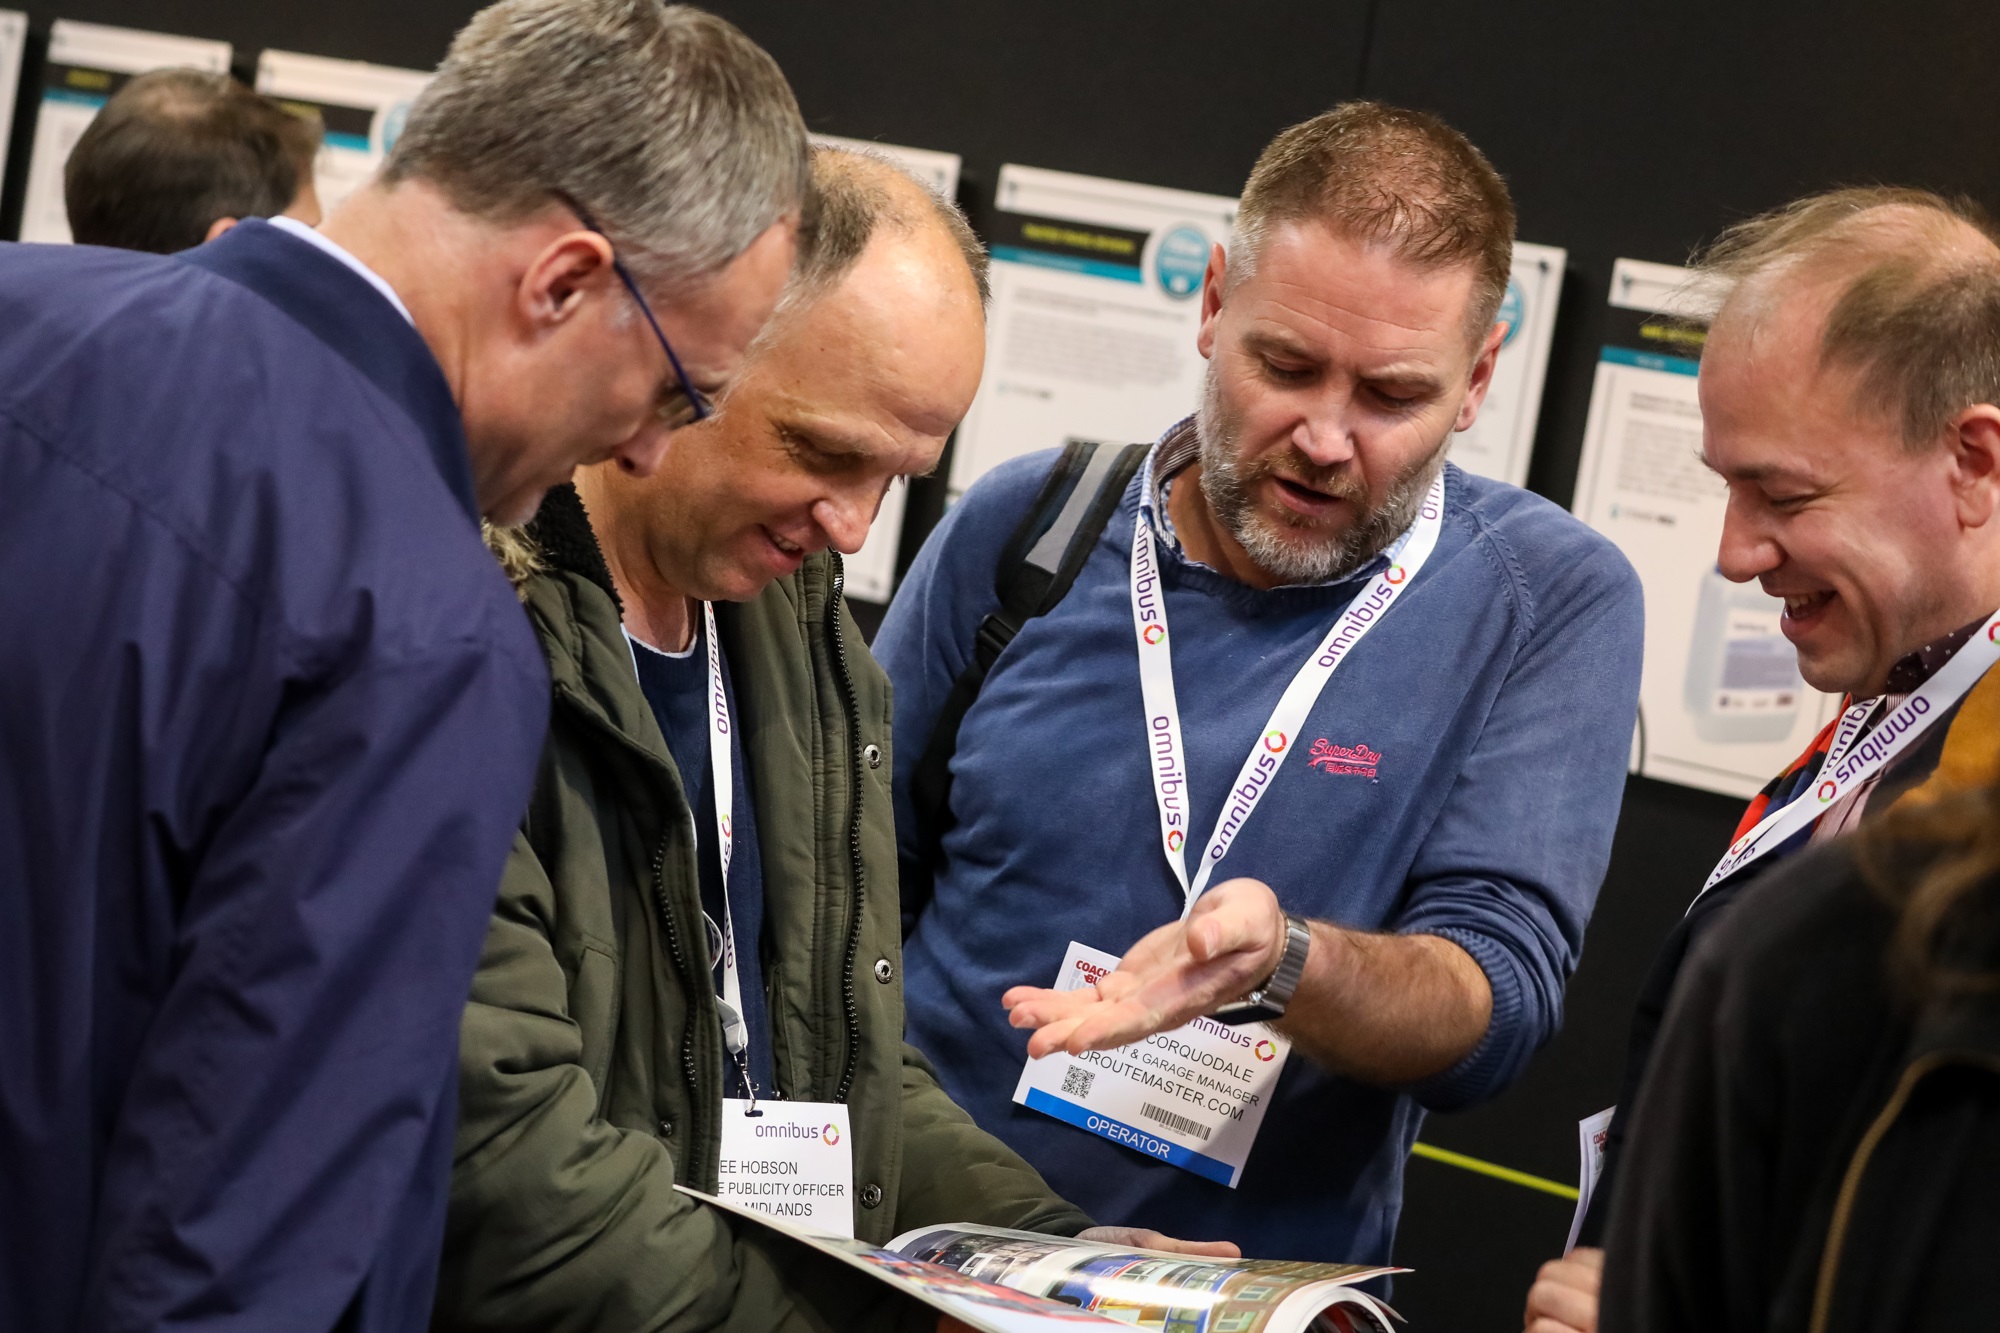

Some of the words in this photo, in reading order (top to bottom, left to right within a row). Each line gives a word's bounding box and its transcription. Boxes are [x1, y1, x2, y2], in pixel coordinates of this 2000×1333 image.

[1136, 524, 1157, 622] omnibus
[1318, 583, 1393, 668] omnibus
[709, 617, 728, 734] omnibus
[1153, 716, 1182, 826] omnibus
[1818, 697, 1879, 781] mnibu
[1839, 696, 1930, 785] omnibus
[1210, 753, 1276, 860] omnibus
[1187, 1017, 1252, 1048] mnibus
[1075, 1048, 1244, 1122] DROUTEMASTER.COM
[1131, 1048, 1139, 1060] &
[1142, 1053, 1195, 1082] GARAGE
[1197, 1074, 1260, 1107] MANAGER
[720, 1160, 737, 1174] EE
[741, 1160, 798, 1175] HOBSON
[755, 1122, 819, 1139] omnibus
[1087, 1115, 1171, 1159] OPERATOR
[728, 1182, 790, 1196] PUBLICITY
[793, 1183, 845, 1197] OFFICER
